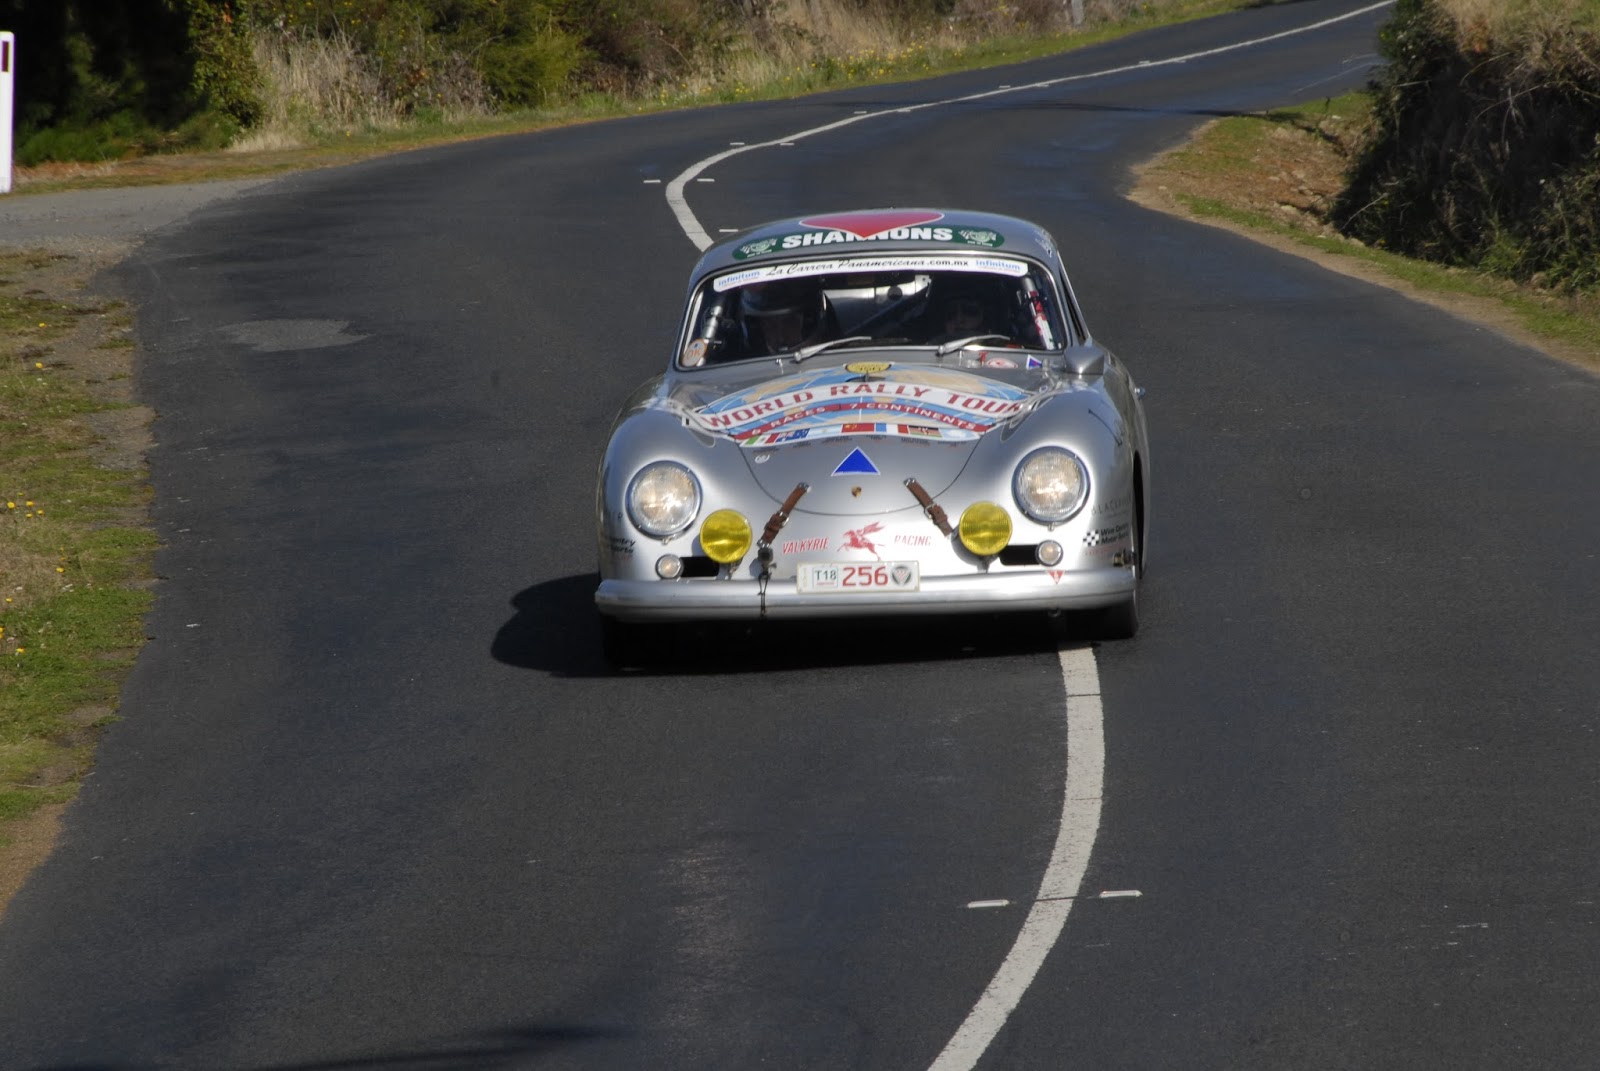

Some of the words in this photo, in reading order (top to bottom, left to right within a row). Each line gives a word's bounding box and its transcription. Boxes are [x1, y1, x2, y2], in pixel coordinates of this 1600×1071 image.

[766, 265, 783, 276] La
[786, 262, 833, 275] Carrera
[975, 259, 1021, 271] infinitum
[718, 270, 761, 286] infinitum
[700, 390, 814, 428] WORLD
[830, 383, 932, 397] RALLY
[770, 406, 826, 428] RACES
[865, 402, 977, 430] CONTINENTS
[782, 537, 830, 554] VALKYRIE
[814, 569, 837, 581] T18
[842, 565, 889, 587] 256
